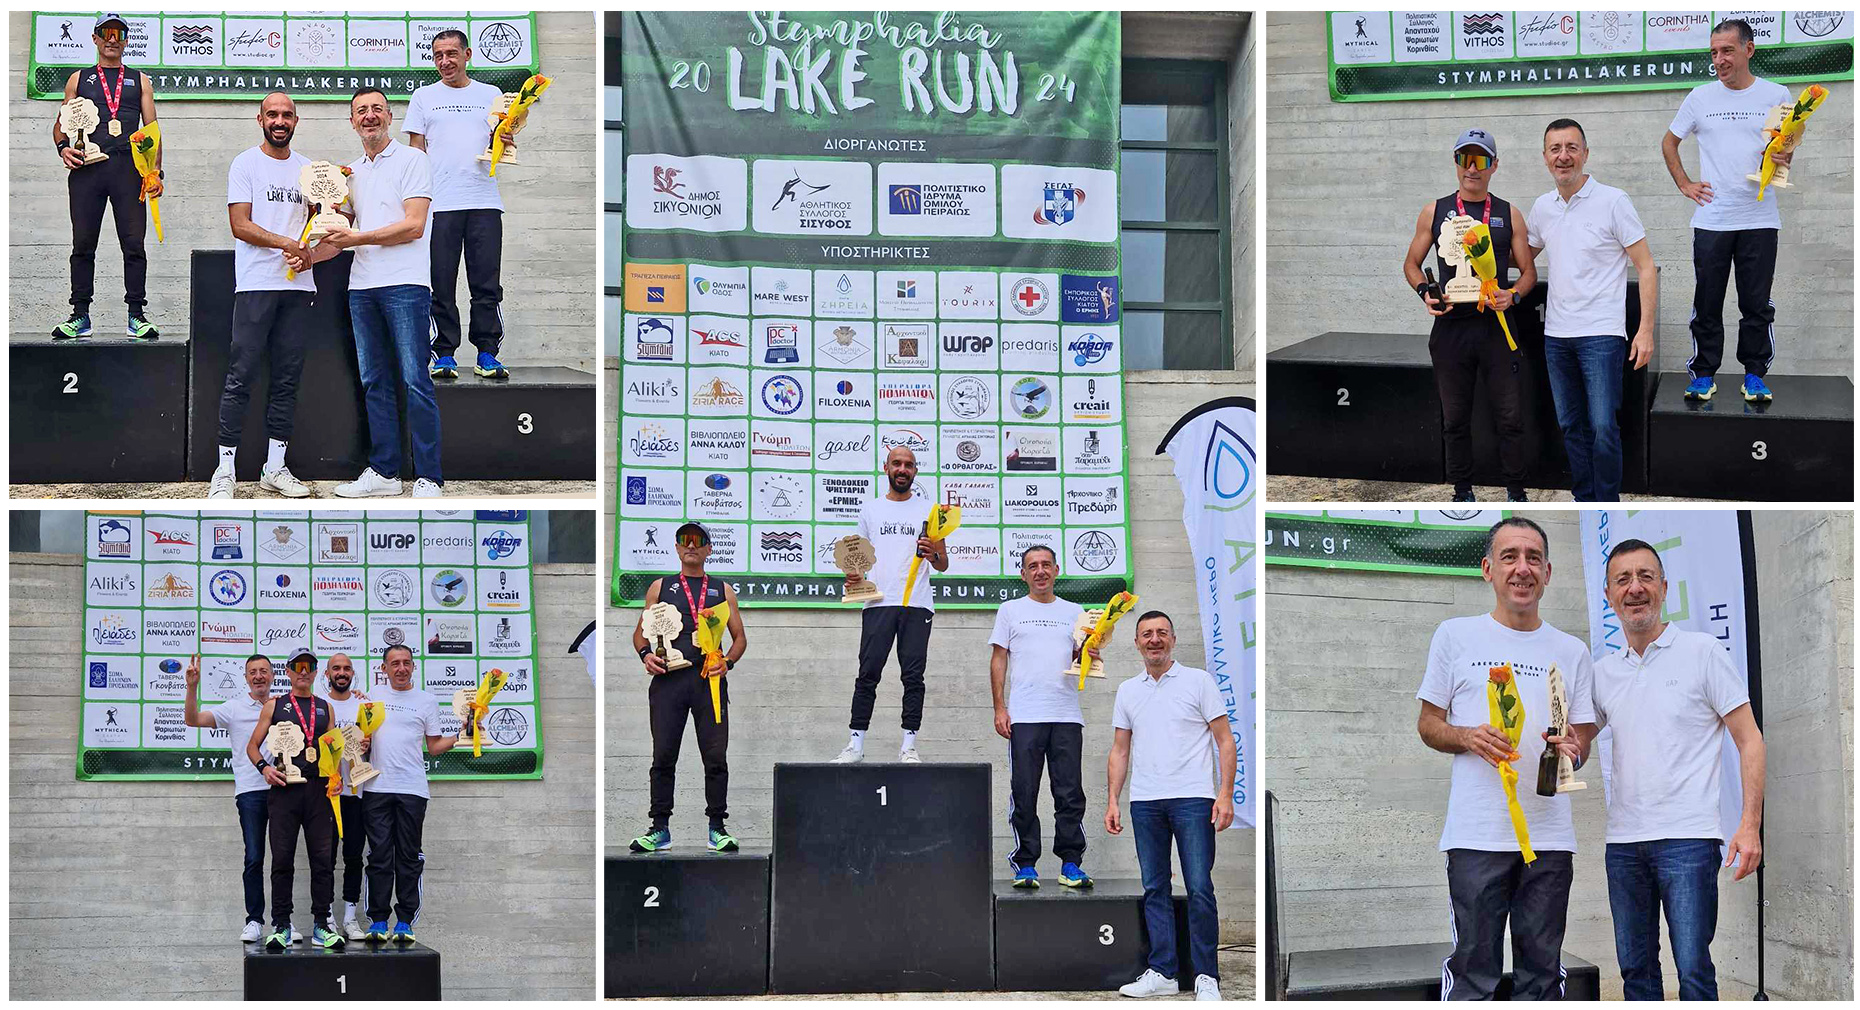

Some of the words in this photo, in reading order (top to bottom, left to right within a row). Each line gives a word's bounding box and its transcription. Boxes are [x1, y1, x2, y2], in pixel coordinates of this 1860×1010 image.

[1405, 12, 1438, 20] Πολιτιστικός
[1648, 15, 1710, 27] CORINTHIA
[1409, 19, 1435, 27] Σύλλογος
[1518, 12, 1560, 41] studio
[1560, 15, 1574, 35] C
[1404, 26, 1440, 35] Απανταχού
[227, 28, 268, 51] studio
[350, 37, 405, 47] CORINTHIA
[478, 39, 524, 50] ALCHEMIST
[1405, 35, 1439, 44] Ψαριωτών
[1464, 36, 1505, 48] VITHOS
[1524, 40, 1569, 48] www.studioc.gr
[172, 45, 213, 56] VITHOS
[1406, 44, 1439, 54] Κορινθίας
[669, 59, 712, 94] 20
[1438, 61, 1717, 85] STYMPHALIALAKERUN.g
[726, 46, 877, 116] LAKE
[900, 47, 1020, 116] RUN
[1035, 73, 1078, 103] 24
[824, 138, 927, 152] ΔΙΟΡΓΑΝΩΤΕΣ
[923, 184, 986, 193] ΠΟΛΙΤΙΣΤΙΚΟ
[1044, 181, 1074, 190] ΣΕΓΑΣ
[267, 190, 284, 203] LAKE
[688, 191, 721, 201] ΔΗΜΟΣ
[923, 192, 962, 200] ΙΔΡΥΜΑ
[800, 202, 852, 210] ΑΘΛΗΤΙΚΟΣ
[923, 200, 964, 208] ΟΜΙΛΟΥ
[800, 210, 847, 219] ΣΥΛΛΟΓΟΣ
[923, 208, 970, 216] ΠΕΙΡΑΙΩΣ
[800, 219, 852, 229] ΣΙΣΥΦΟΣ
[821, 245, 930, 259] ΥΠΟΣΤΗΡΙΚΤΕΣ
[631, 272, 656, 280] ΤΡΑΠΕΖΑ
[712, 282, 746, 291] ΟΛΥΜΠΙΑ
[712, 288, 733, 297] ΟΔΟΣ
[754, 293, 781, 302] MARE
[783, 294, 809, 303] WEST
[942, 299, 995, 307] TOURIX
[705, 329, 741, 343] ACS
[769, 328, 785, 345] pc
[772, 337, 794, 345] doctor
[943, 336, 994, 353] wrap
[1002, 339, 1058, 354] predaris
[62, 372, 80, 395] 2
[627, 379, 679, 397] Aliki's
[692, 397, 716, 406] ZIRIA
[718, 397, 744, 406] RACE
[818, 397, 871, 408] FILOXENIA
[1336, 388, 1351, 406] 2
[1073, 400, 1110, 410] creait
[516, 412, 535, 435] 3
[690, 430, 746, 440] ΒΙΒΛΙΟΠΩΛΕΙΟ
[752, 432, 791, 448] Γνώμη
[690, 440, 715, 448] ΑΝΝΑ
[717, 441, 746, 449] ΚΑΛΟΥ
[818, 434, 870, 460] gasel
[1751, 440, 1768, 460] 3
[822, 478, 869, 487] ΞΕΝΟΔΟΧΕΙΟ
[825, 486, 866, 494] ΨΗΣΤΑΡΙΑ
[693, 497, 743, 510] Γκουβάτσος
[828, 496, 863, 505] «ΕΡΜΗΣ»
[1004, 499, 1060, 507] LIAKOPOULOS
[1068, 501, 1118, 515] Πρεδάρη
[159, 530, 190, 541] ACS
[216, 528, 230, 543] pc
[880, 525, 898, 535] LAKE
[900, 525, 915, 536] RUN
[1012, 532, 1053, 540] Πολιτιστικός
[371, 533, 416, 549] wrap
[423, 537, 474, 549] predaris
[944, 545, 999, 555] CORINTHIA
[1072, 549, 1119, 557] ALCHEMIST
[760, 552, 803, 563] VITHOS
[90, 576, 136, 591] Aliki's
[148, 590, 169, 598] ZIRIA
[171, 590, 194, 598] RACE
[259, 590, 307, 599] FILOXENIA
[487, 589, 520, 600] creait
[146, 620, 196, 629] ΒΙΒΛΙΟΠΩΛΕΙΟ
[201, 621, 237, 635] Γνώμη
[170, 629, 196, 637] ΚΑΛΟΥ
[259, 622, 306, 646] gasel
[149, 680, 188, 691] Γκουβάτσο
[155, 725, 187, 734] Ψαριωτών
[488, 724, 529, 732] ALCHEMIST
[155, 733, 186, 742] Κορινθίας
[875, 785, 888, 806] 1
[643, 886, 660, 908] 2
[1098, 925, 1116, 946] 3
[336, 975, 347, 994] 1
